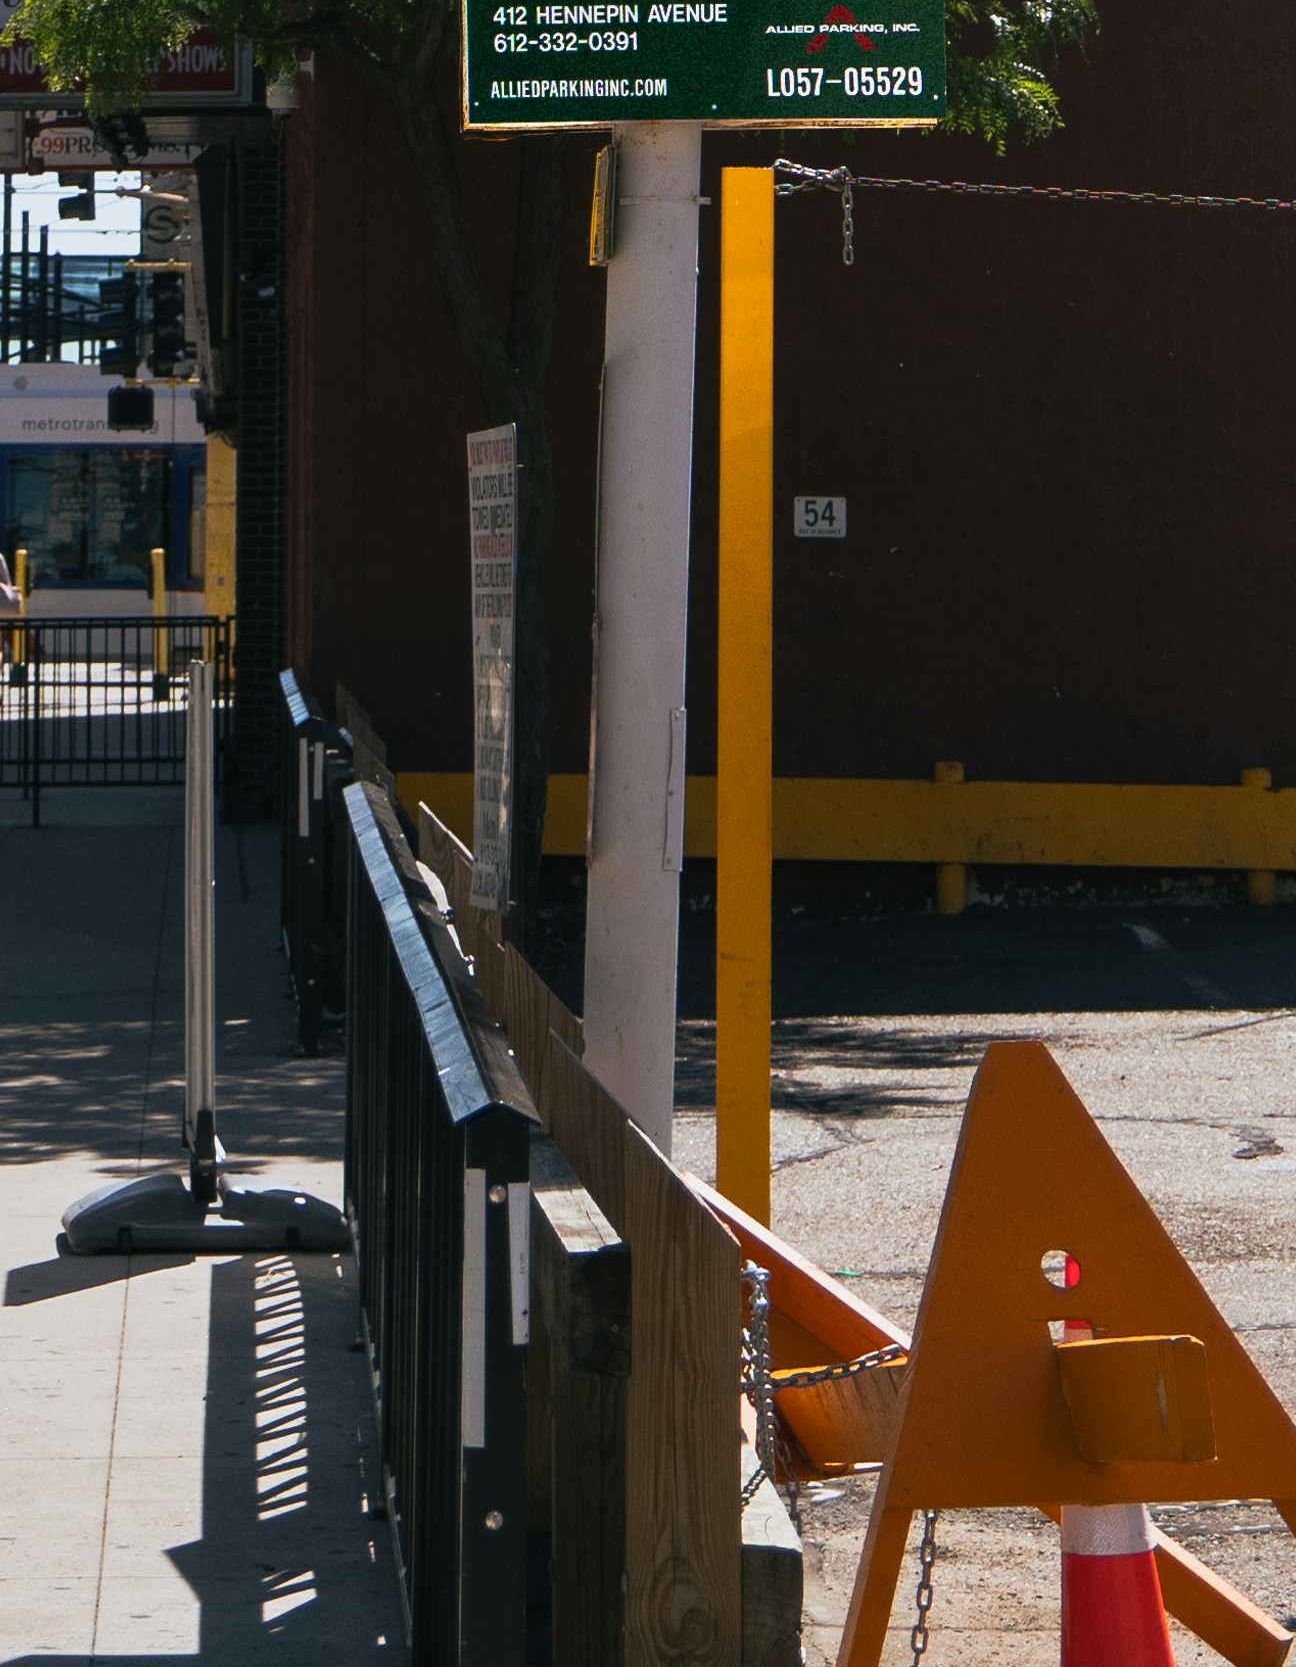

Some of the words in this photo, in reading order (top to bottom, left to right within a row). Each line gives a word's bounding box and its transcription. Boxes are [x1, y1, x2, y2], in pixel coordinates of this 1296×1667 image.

[492, 5, 529, 26] 412
[536, 3, 640, 25] HENNEPIN
[647, 2, 729, 23] AVENUE
[765, 24, 816, 34] ALLIED
[819, 23, 889, 35] PARKING,
[892, 22, 922, 33] INC.
[493, 30, 639, 54] 612-332-0391
[490, 77, 668, 100] ALLIEDPARKINGINC.COM
[804, 499, 836, 528] 54
